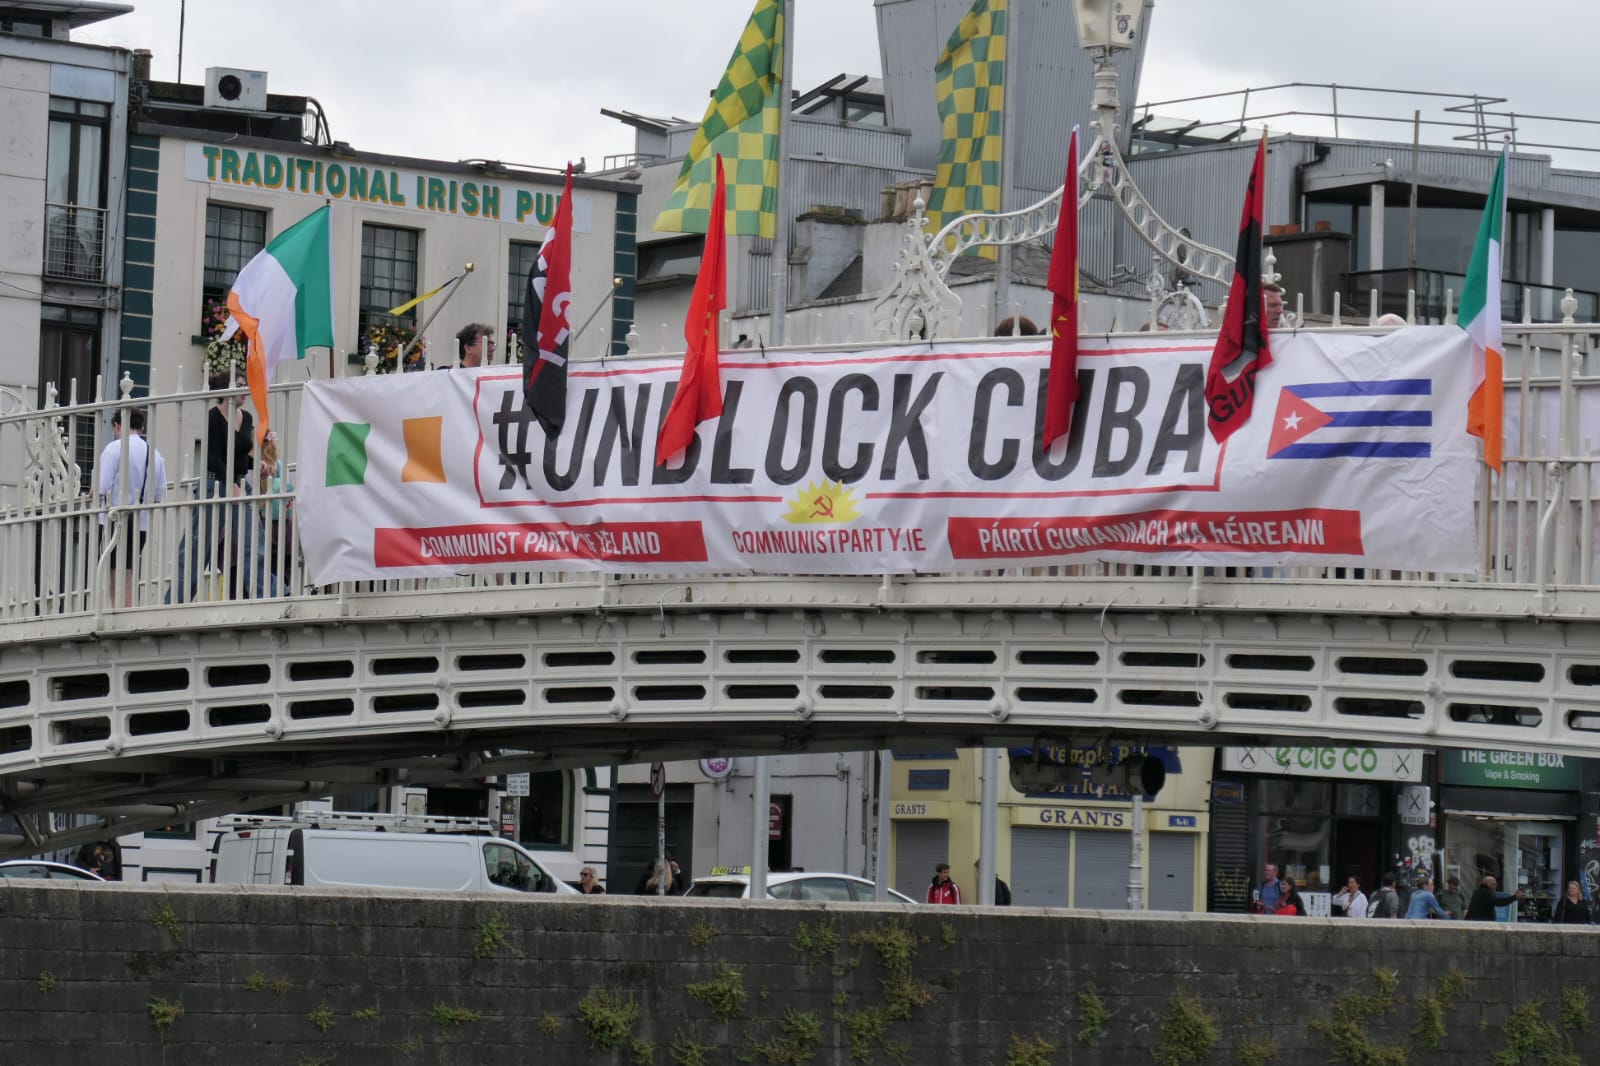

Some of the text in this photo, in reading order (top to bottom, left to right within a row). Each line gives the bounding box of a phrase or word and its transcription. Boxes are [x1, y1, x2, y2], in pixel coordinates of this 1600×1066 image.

[203, 145, 566, 228] TRADITIONAL IRISH PU
[968, 363, 1205, 481] CUBA
[420, 532, 520, 558] COMMUNIST
[524, 531, 580, 554] PARTY
[732, 528, 927, 554] COMMUNISTPARTY.IE
[978, 517, 1324, 552] PÁIRTÍ CUMANNACH NA hÉIREANN
[1298, 747, 1336, 769] CIG
[1343, 748, 1378, 772] CO
[1462, 750, 1565, 768] THE GREEN BOX
[1485, 769, 1502, 780] Vape
[1511, 770, 1540, 783] Smoking
[895, 804, 926, 815] GRANTS
[1040, 809, 1124, 826] GRANTS
